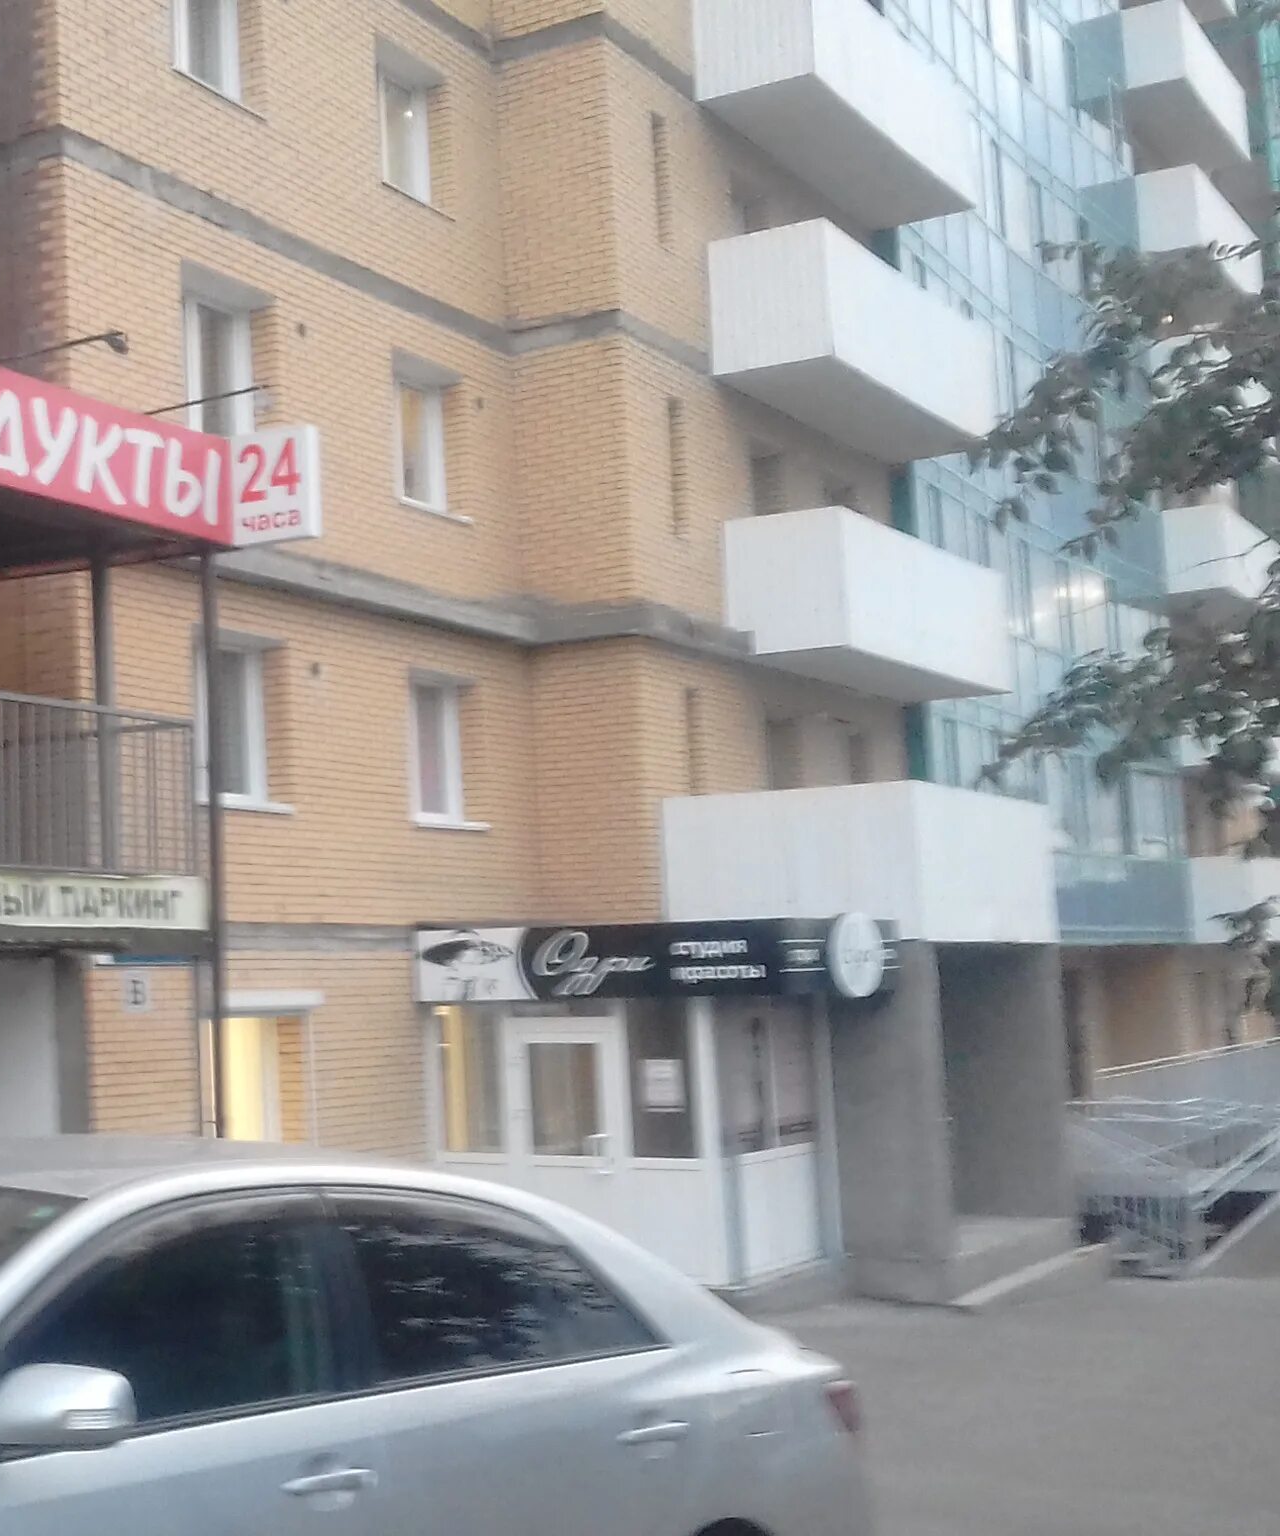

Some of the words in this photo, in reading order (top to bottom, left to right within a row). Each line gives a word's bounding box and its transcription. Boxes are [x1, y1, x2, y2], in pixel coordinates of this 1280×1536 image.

[238, 437, 301, 503] 24
[242, 509, 301, 531] часа
[60, 885, 184, 920] ПАРКИНГ
